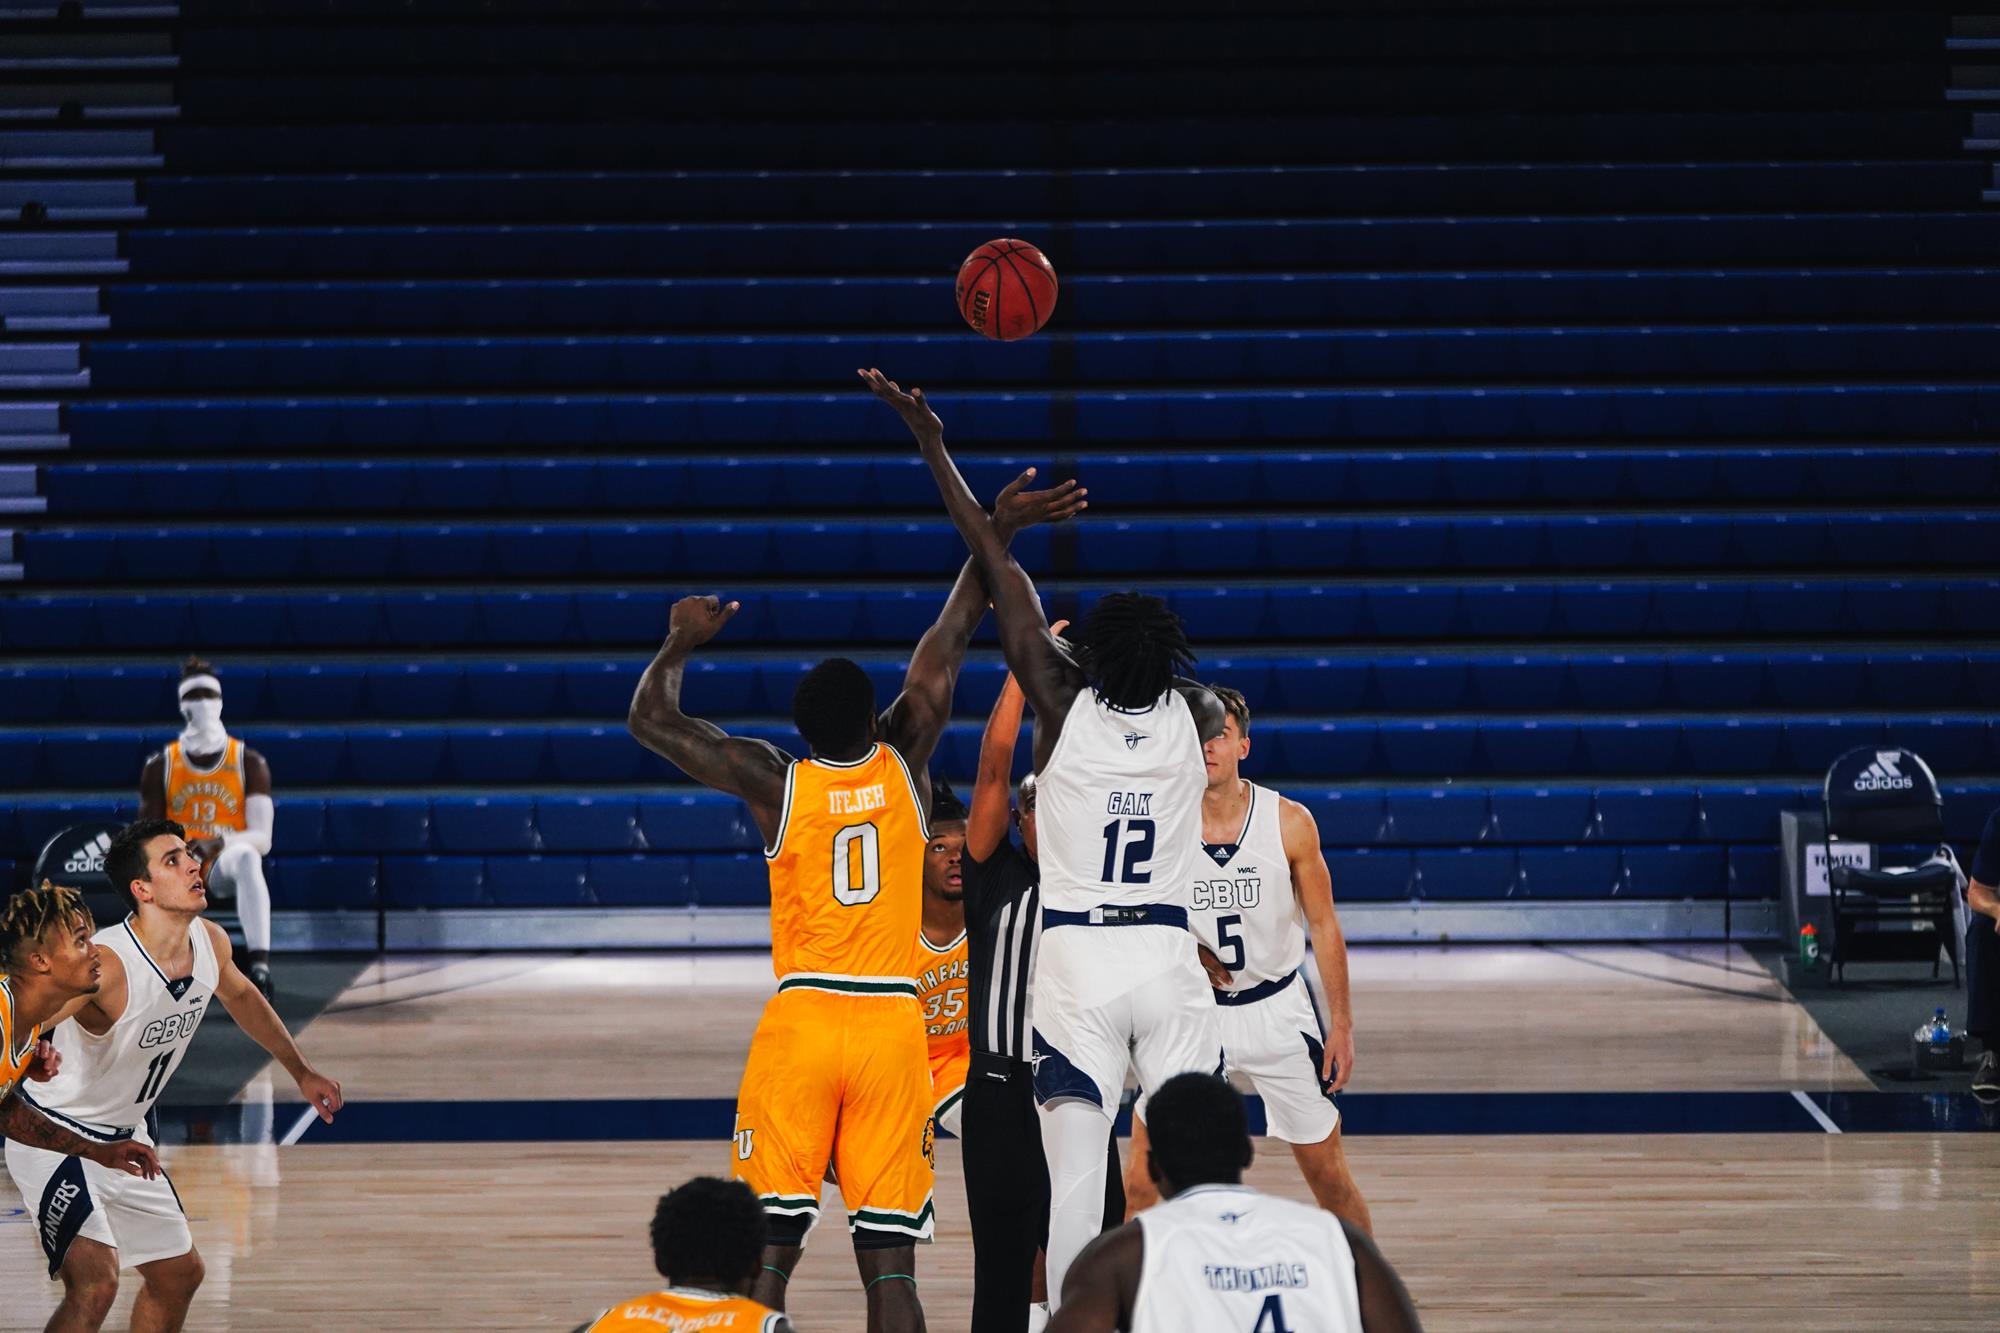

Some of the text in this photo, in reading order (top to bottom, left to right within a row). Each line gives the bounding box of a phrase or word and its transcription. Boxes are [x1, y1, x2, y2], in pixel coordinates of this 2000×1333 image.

[828, 784, 886, 814] IFEJEH
[1854, 775, 1913, 791] adidas
[192, 800, 217, 822] 13
[1108, 791, 1153, 815] GAK
[832, 821, 880, 907] 0
[1101, 819, 1155, 884] 12
[1189, 878, 1261, 911] CBU
[1217, 914, 1245, 972] 5
[923, 987, 967, 1020] 35
[139, 1007, 202, 1049] CBU
[135, 1047, 176, 1104] 11
[45, 1179, 81, 1253] LANCERS
[1205, 1264, 1309, 1293] THOMAS
